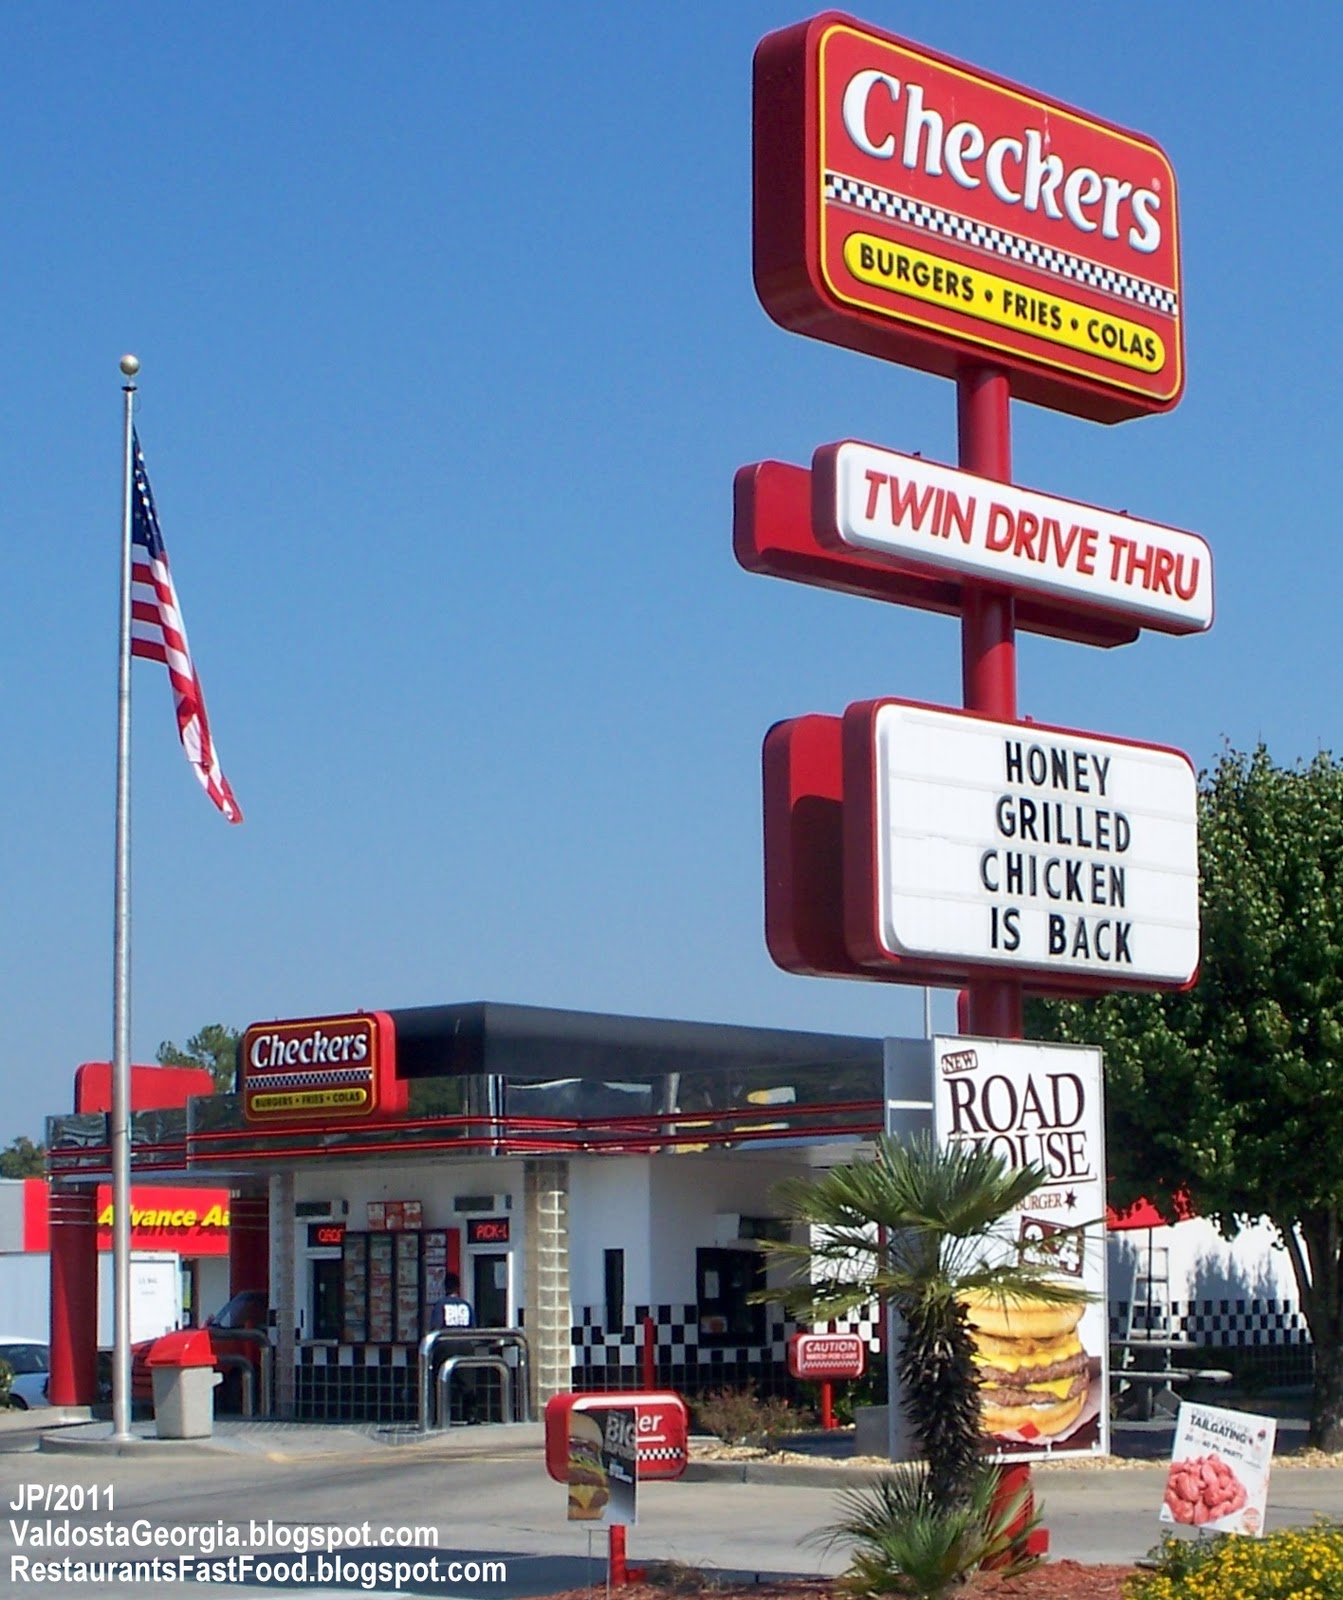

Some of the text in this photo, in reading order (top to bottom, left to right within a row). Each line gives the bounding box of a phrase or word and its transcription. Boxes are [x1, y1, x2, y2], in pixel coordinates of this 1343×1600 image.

[842, 68, 1161, 254] Checkers
[859, 242, 1157, 361] BURGERS FRIES COLAS
[865, 469, 1200, 601] TWIN DRIVE THRU
[1005, 740, 1110, 796] HONEY
[996, 794, 1131, 853] GRILLED
[979, 848, 1126, 908] CHICKEN
[991, 906, 1132, 963] IS BACK
[250, 1030, 368, 1069] Checkers
[944, 1054, 974, 1072] NEW
[255, 1094, 293, 1108] BURGERS
[333, 1090, 360, 1103] COLAS
[943, 1073, 1086, 1136] ROAD
[98, 1204, 197, 1227] Avance
[806, 1341, 857, 1353] CAUTION
[1190, 1414, 1247, 1444] TAILGATING
